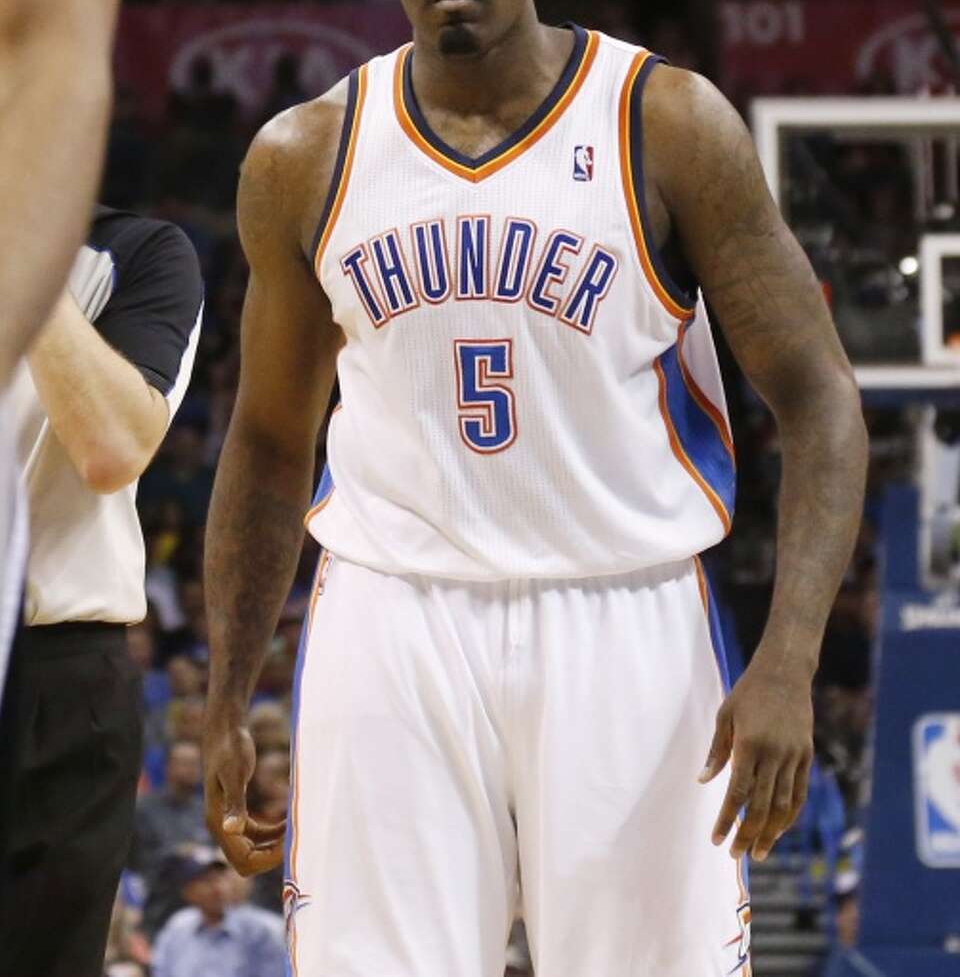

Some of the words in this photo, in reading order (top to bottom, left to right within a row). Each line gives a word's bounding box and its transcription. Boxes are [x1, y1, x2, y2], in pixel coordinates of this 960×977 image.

[724, 2, 806, 46] 101
[340, 214, 619, 336] THUNDER
[454, 338, 518, 455] 5
